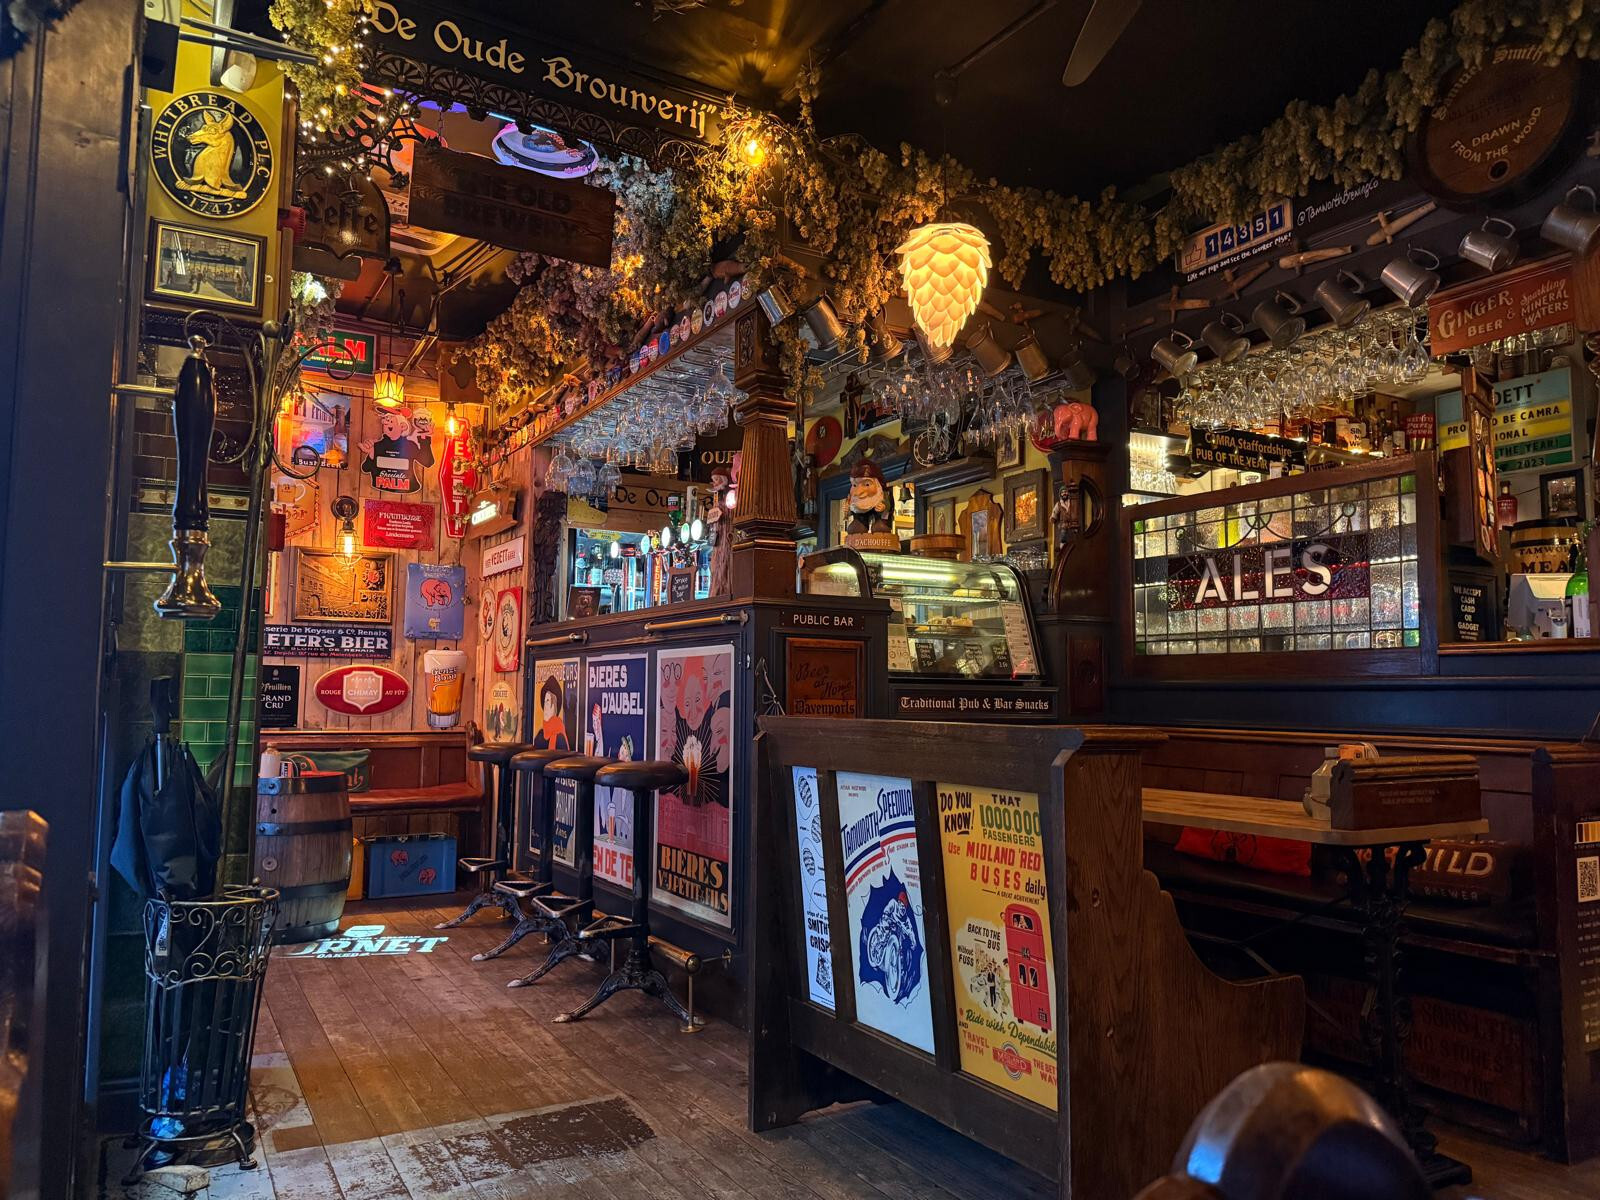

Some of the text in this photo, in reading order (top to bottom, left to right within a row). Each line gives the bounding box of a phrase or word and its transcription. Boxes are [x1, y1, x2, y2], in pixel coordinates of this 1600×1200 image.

[369, 0, 417, 41] De
[433, 20, 526, 74] Oude
[1492, 44, 1543, 64] Smith
[154, 94, 271, 178] WHITBREAD PLC
[1451, 106, 1542, 163] FROM THE WOOD
[1472, 119, 1520, 148] DRAWN
[189, 197, 234, 215] 1742
[1437, 289, 1514, 339] GINGER
[1467, 319, 1503, 337] BEER
[1521, 291, 1569, 317] MINERAL
[1525, 300, 1569, 327] WATERS
[1447, 423, 1467, 436] PRO
[1503, 415, 1516, 424] BE
[1520, 405, 1560, 421] CAMRA
[1495, 428, 1529, 441] IONAL
[1204, 431, 1292, 459] CAMRA Staffordshire
[1195, 447, 1213, 461] PUB
[1215, 450, 1227, 463] OF
[1229, 453, 1245, 466] THE
[1517, 457, 1545, 469] 2023
[375, 477, 410, 490] PALM
[615, 485, 637, 505] De
[1194, 543, 1332, 604] ALES
[1521, 560, 1568, 574] MEA
[1460, 595, 1475, 605] CASH
[1463, 588, 1481, 597] ACCEPT
[1460, 604, 1476, 613] CARD
[793, 614, 854, 626] PUBLIC BAR
[1457, 621, 1480, 631] GADGET
[1464, 614, 1473, 622] OR
[291, 626, 303, 634] De
[304, 627, 337, 636] Keyser
[338, 628, 345, 636] &
[357, 629, 387, 637] Renaix
[263, 633, 389, 650] ETER'S BIER
[588, 664, 630, 689] BIERES
[261, 694, 292, 702] GRAND
[265, 701, 285, 709] CRU
[794, 699, 856, 715] Davenports
[900, 696, 1049, 711] Traditional Pub & Bar Snacks
[877, 787, 913, 823] SPEEDWA
[940, 791, 973, 813] DO YOU
[991, 794, 1022, 808] THAT
[944, 809, 975, 833] KNOW!
[840, 809, 881, 860] TAMWORTH
[982, 828, 1036, 847] PASSENGERS
[947, 842, 961, 856] Use
[966, 841, 1016, 867] MIDLAND
[970, 862, 1046, 901] BUSES daily
[807, 917, 831, 936] SMITH'
[967, 923, 1001, 941] BACK TO THE
[809, 935, 831, 953] CRISP
[957, 944, 974, 956] without
[987, 939, 1001, 952] BUS
[958, 954, 974, 967] FUSS
[958, 1020, 969, 1029] AND
[966, 1008, 1057, 1056] Ride with Dependabili
[962, 1029, 990, 1049] TRAVEL
[965, 1042, 984, 1056] WITH
[1033, 1058, 1044, 1071] THE
[1044, 1064, 1057, 1076] BET
